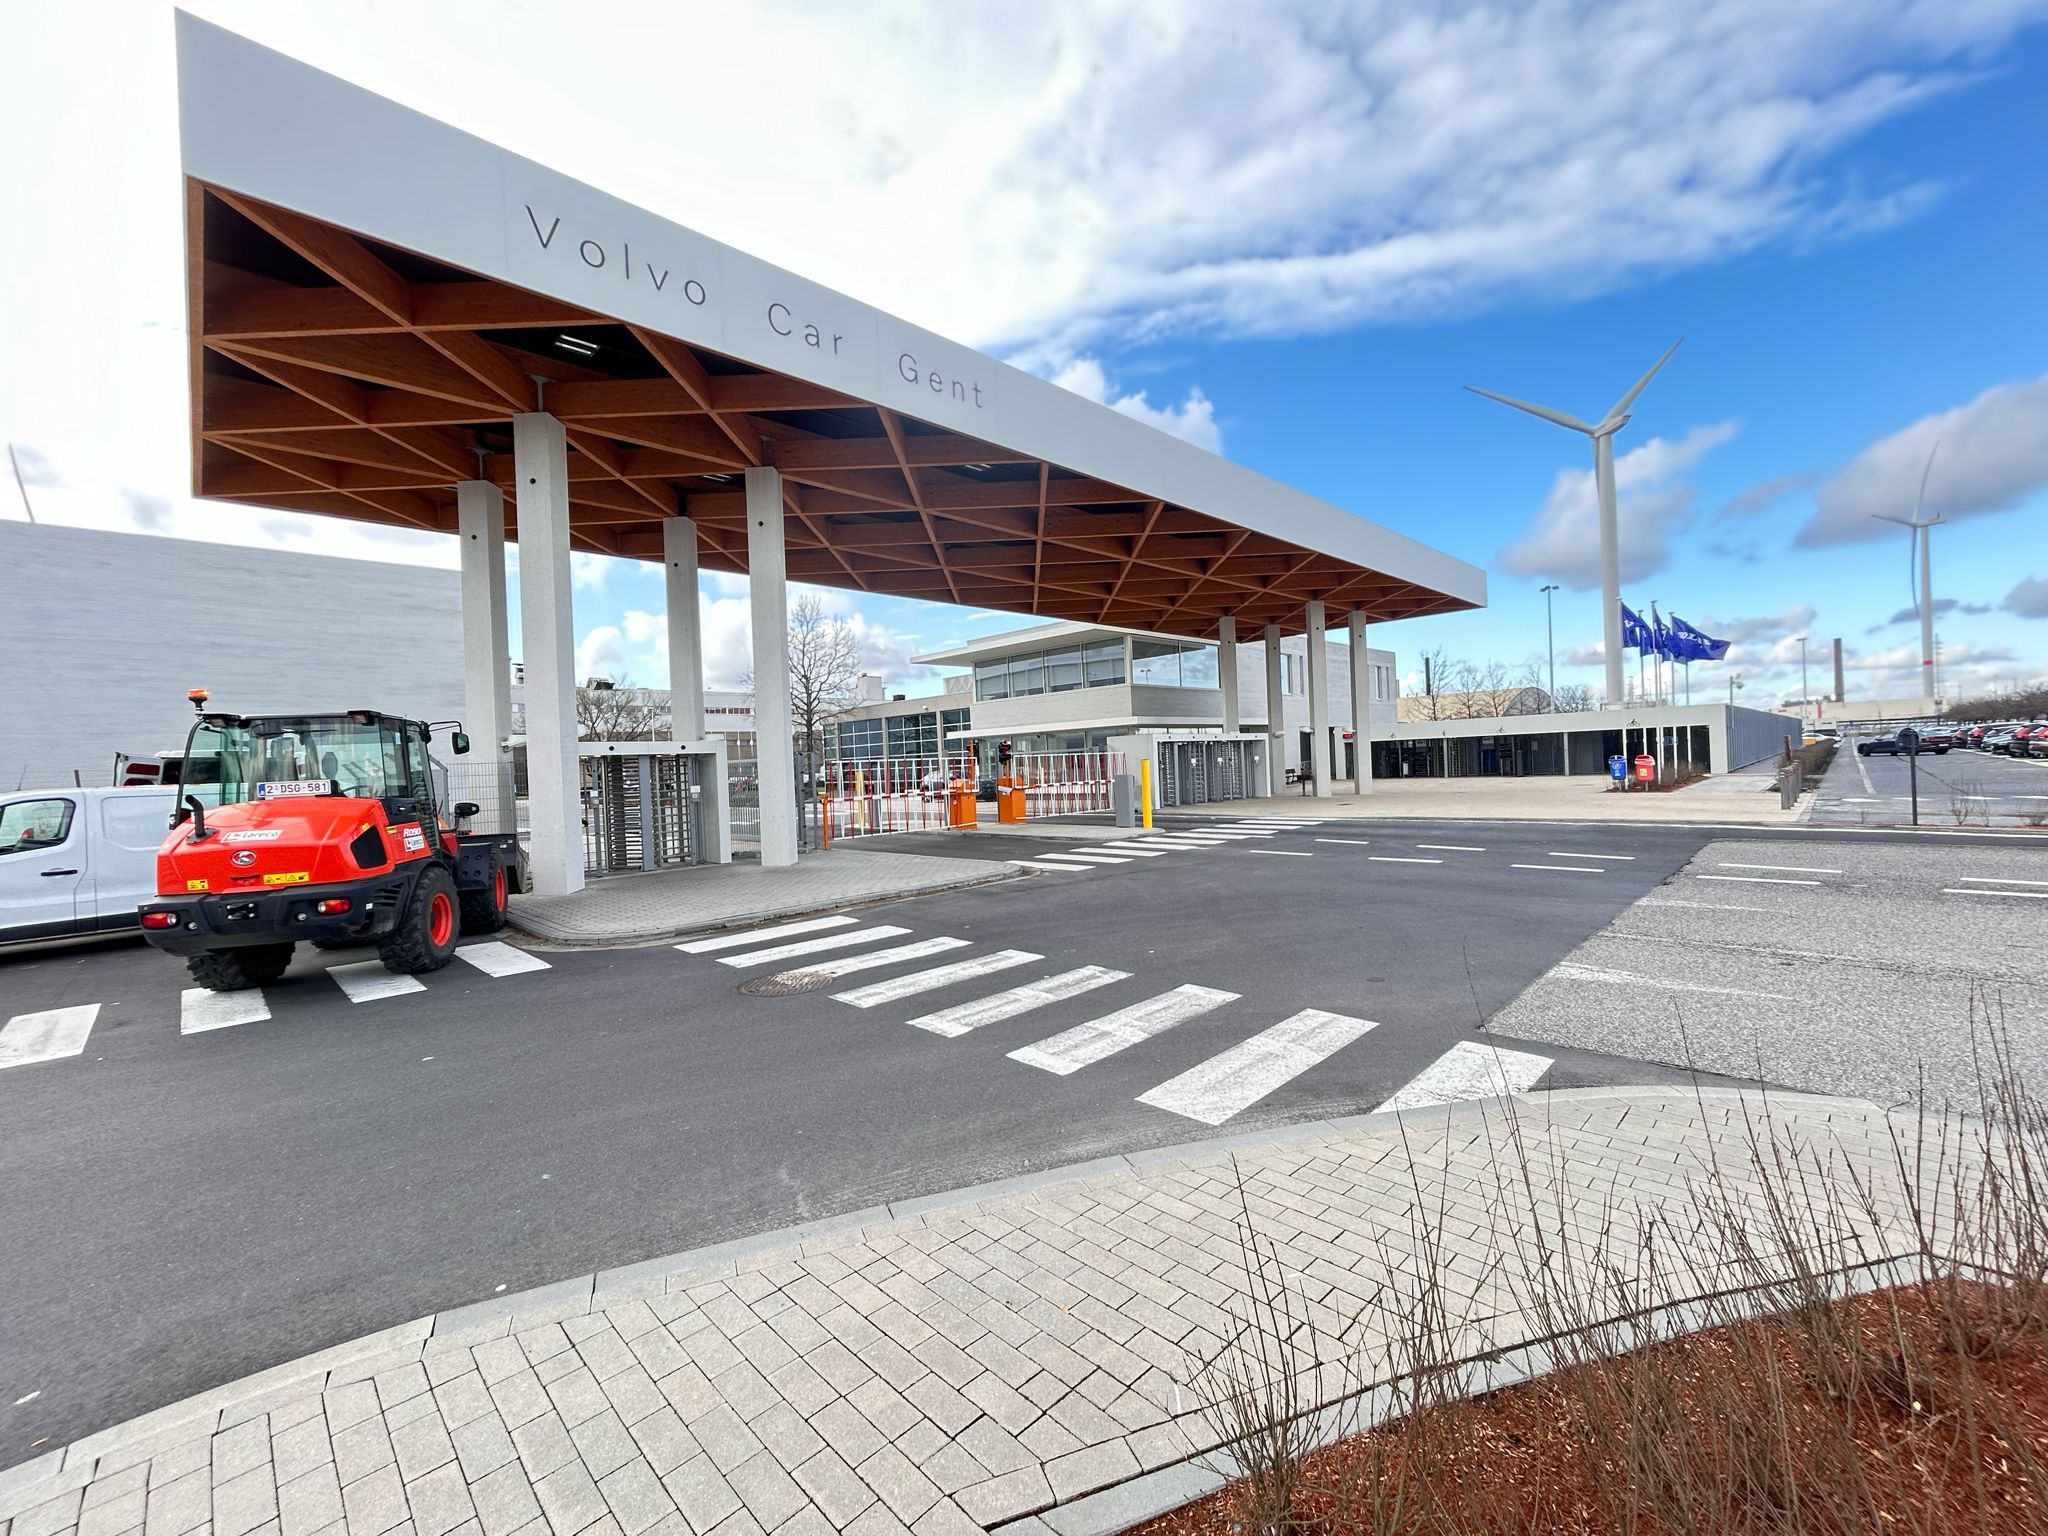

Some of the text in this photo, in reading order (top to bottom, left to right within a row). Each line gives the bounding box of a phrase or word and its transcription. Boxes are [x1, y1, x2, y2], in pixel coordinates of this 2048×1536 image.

[525, 204, 984, 409] Volvo Car Gent
